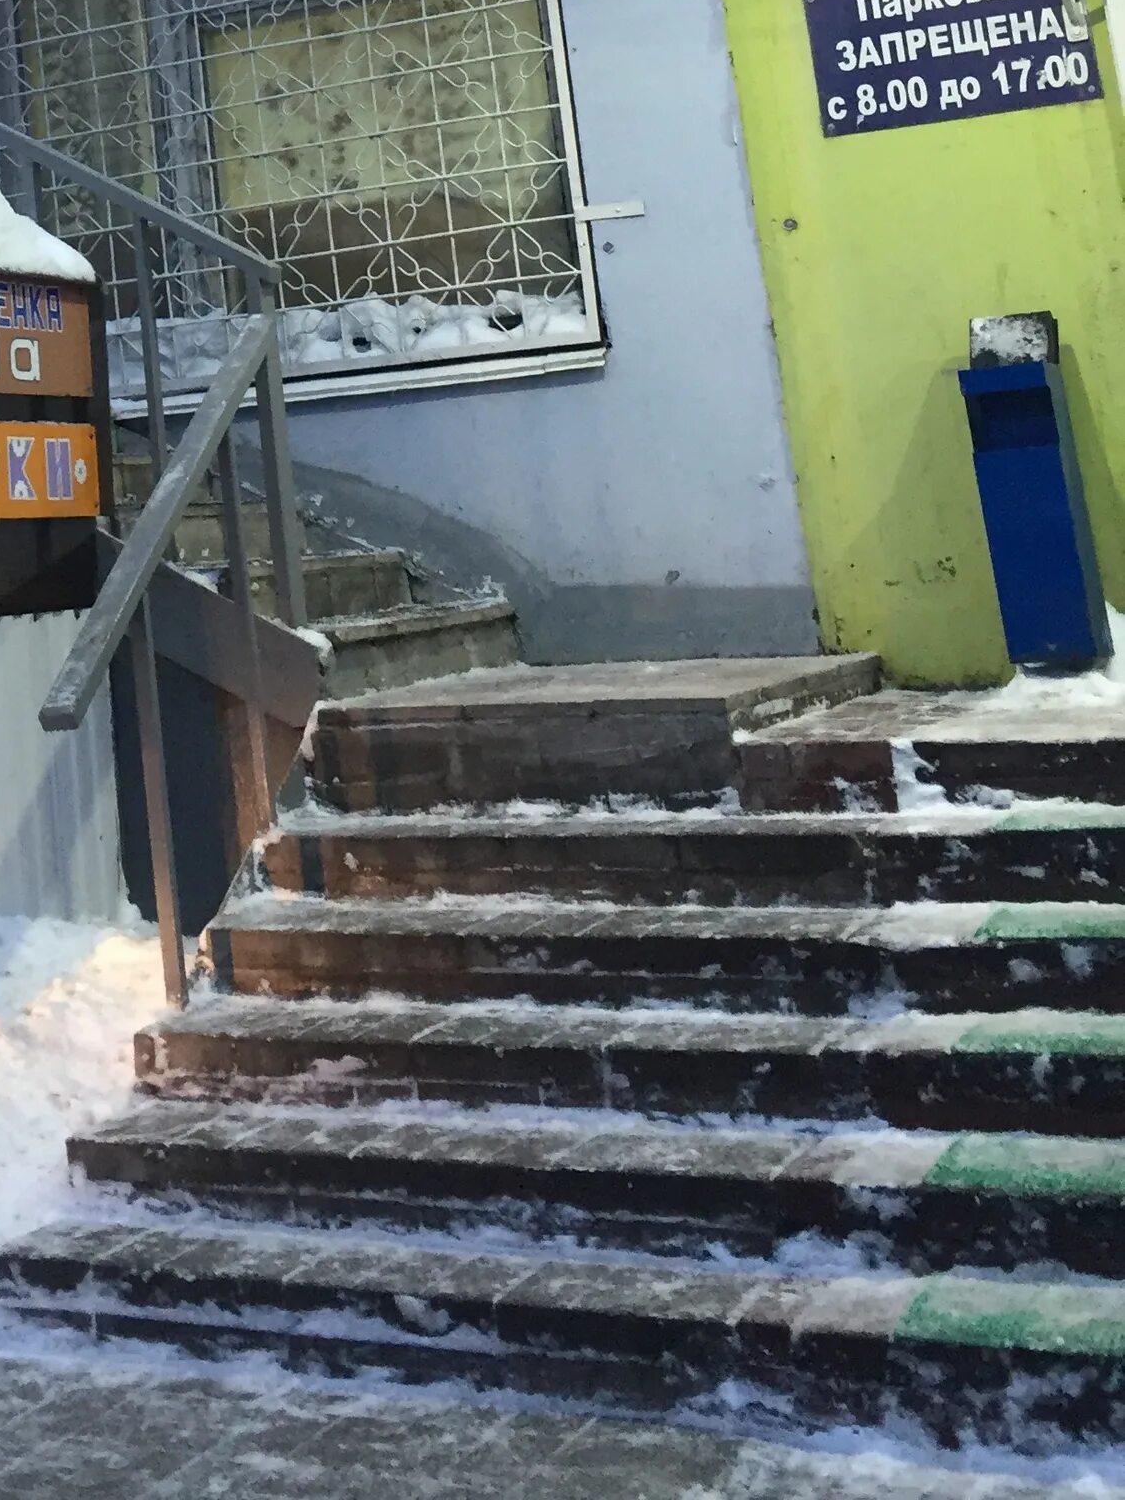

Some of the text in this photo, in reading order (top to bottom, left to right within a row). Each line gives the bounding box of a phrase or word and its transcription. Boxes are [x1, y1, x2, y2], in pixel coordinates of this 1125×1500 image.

[835, 7, 1064, 71] ЗАПРЕЩЕНА
[827, 51, 1089, 120] с 8.00 до 17.00
